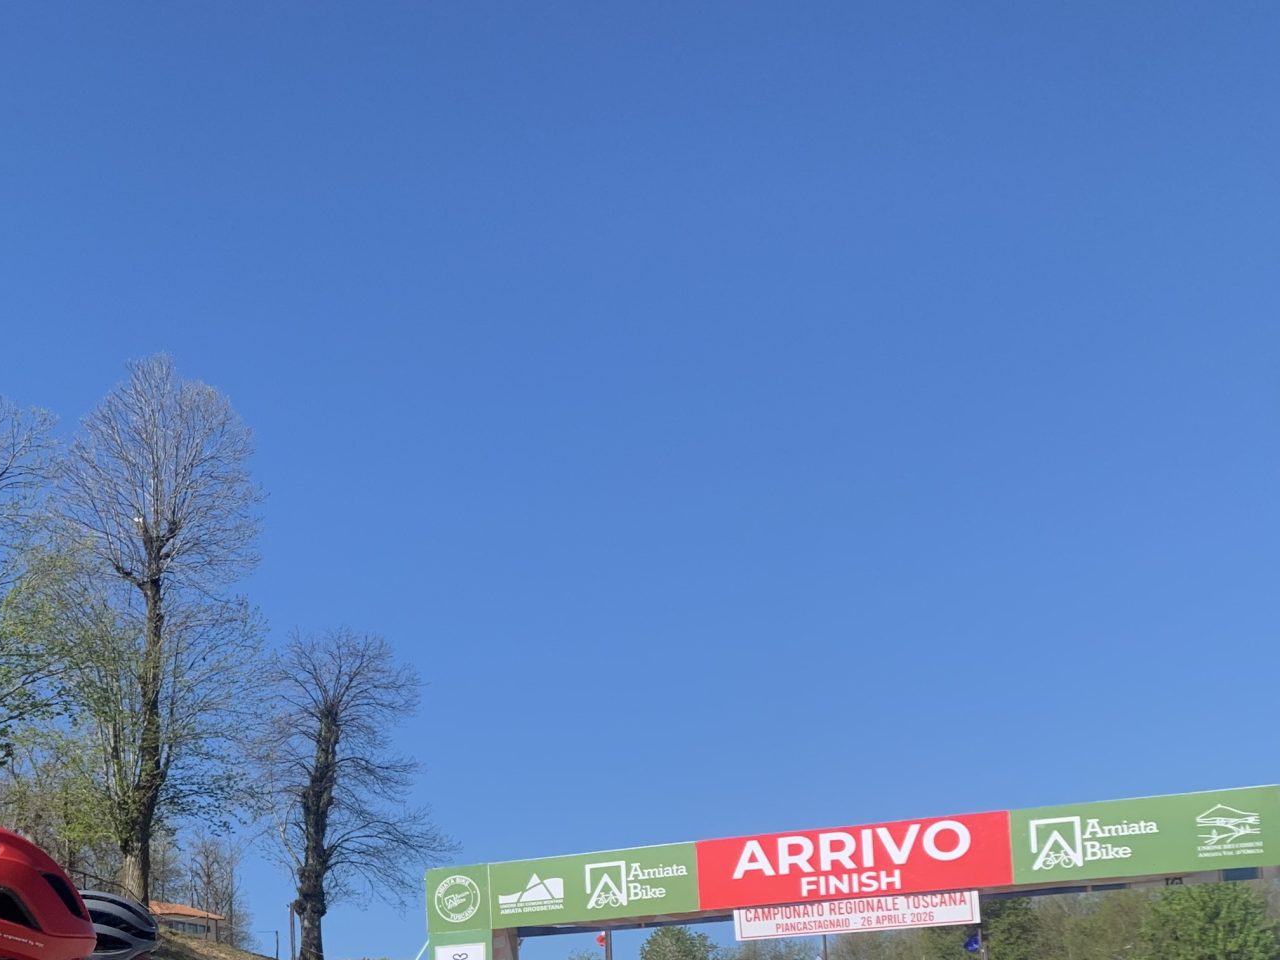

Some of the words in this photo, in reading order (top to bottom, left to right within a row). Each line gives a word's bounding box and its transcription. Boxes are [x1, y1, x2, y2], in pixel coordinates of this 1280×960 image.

[1082, 818, 1159, 838] Amiata
[732, 820, 971, 880] ARRIVO
[1084, 841, 1132, 861] Bike
[627, 862, 688, 881] Amiata
[628, 883, 666, 901] Bike
[800, 869, 902, 898] FINISH
[500, 907, 523, 915] AMIATA
[523, 903, 564, 913] GROSSETANA
[744, 902, 825, 923] CAMPIONATO
[829, 896, 899, 916] REGIONALE
[904, 891, 968, 909] TOSCANA
[775, 917, 851, 934] PIANCASTAGNAIO
[861, 916, 873, 927] 26
[875, 912, 908, 926] APRILE
[910, 910, 935, 925] 2026
